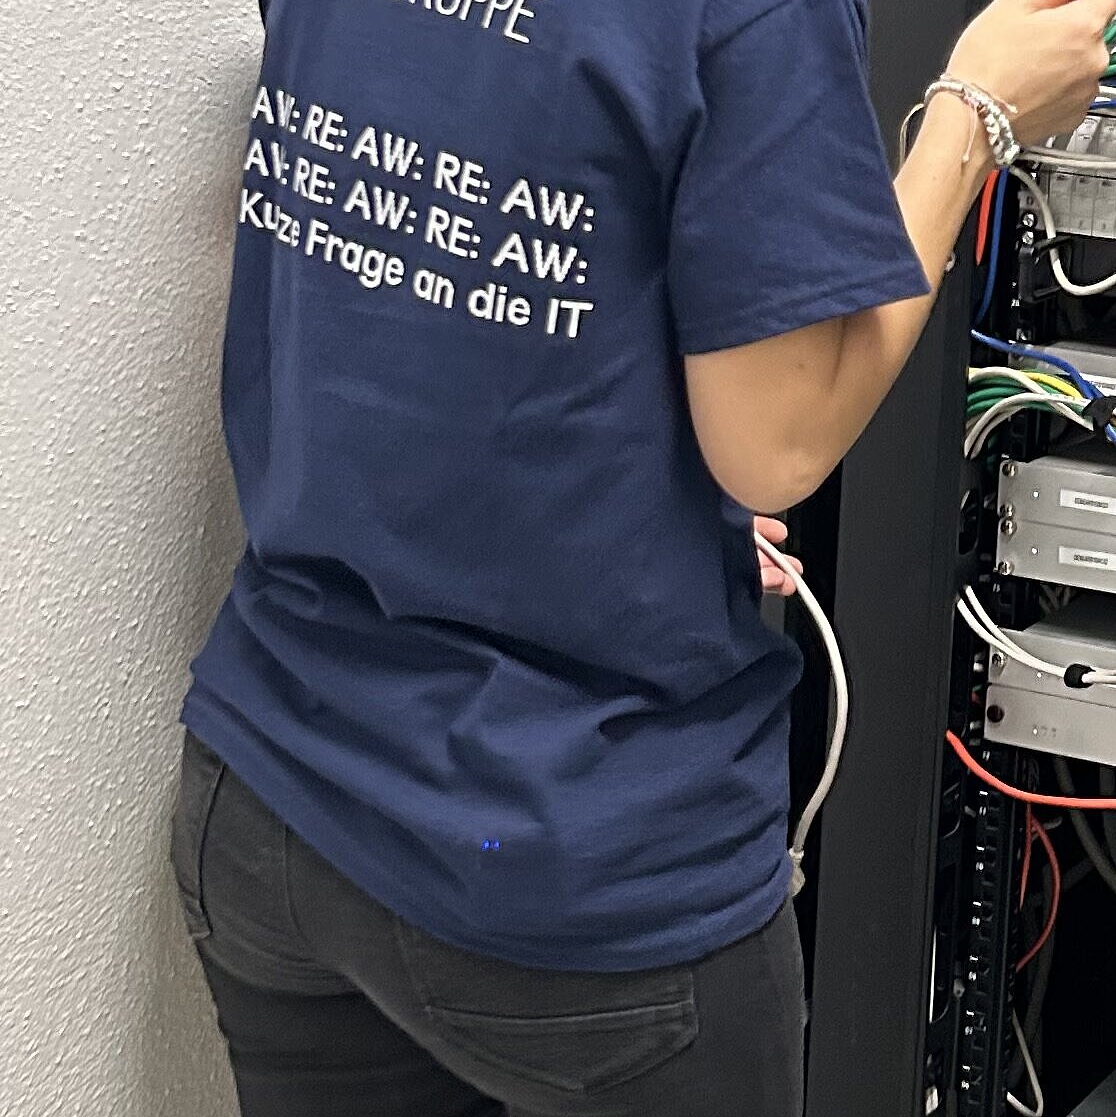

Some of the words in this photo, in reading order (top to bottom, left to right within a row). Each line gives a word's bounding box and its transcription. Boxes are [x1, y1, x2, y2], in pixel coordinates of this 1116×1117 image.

[293, 156, 336, 205] RE:
[343, 179, 418, 234] AW:
[425, 206, 481, 259] RE:
[491, 232, 588, 284] AW:
[302, 104, 348, 152] RE:
[351, 126, 425, 181] AW:
[434, 151, 491, 205] RE:
[501, 179, 594, 232] AW:
[305, 219, 406, 289] Frage
[413, 269, 455, 309] an
[467, 283, 531, 326] die
[546, 298, 594, 338] IT
